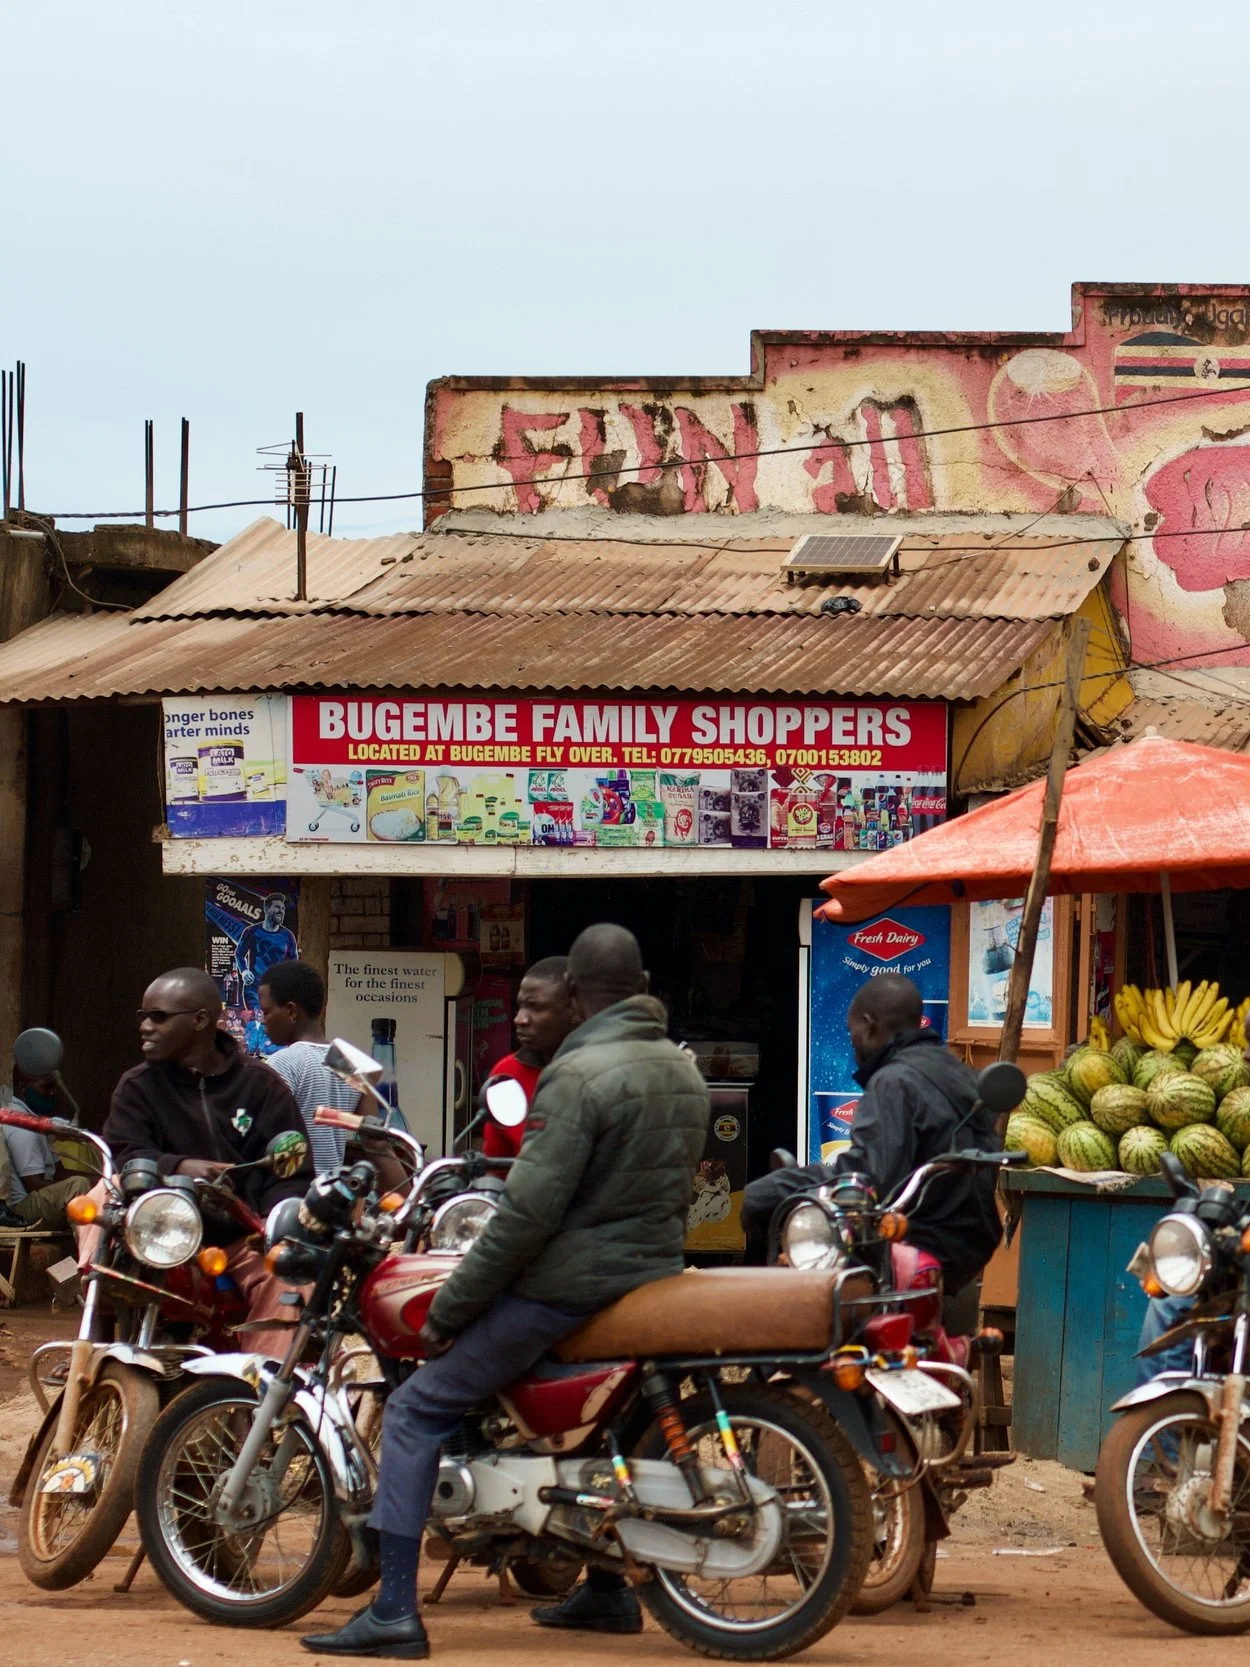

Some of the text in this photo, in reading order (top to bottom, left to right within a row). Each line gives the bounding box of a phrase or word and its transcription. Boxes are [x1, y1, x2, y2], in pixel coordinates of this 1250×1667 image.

[209, 708, 254, 721] bones
[205, 722, 250, 737] minds
[319, 702, 912, 747] BUGEMBE FAMILY SHOPPERS
[348, 744, 882, 767] LOCATED AT BUGEMBE FLY OVER. TEL: 0779505436, 0700153802
[216, 883, 229, 894] GO
[216, 892, 262, 920] GOOAALS
[211, 937, 229, 945] WIN
[854, 931, 919, 947] Fresh Dairy
[334, 963, 438, 977] The finest water
[842, 956, 932, 977] Simply good for you
[345, 977, 425, 990] for the finest
[355, 991, 418, 1003] occasions
[834, 1108, 854, 1116] Fresh
